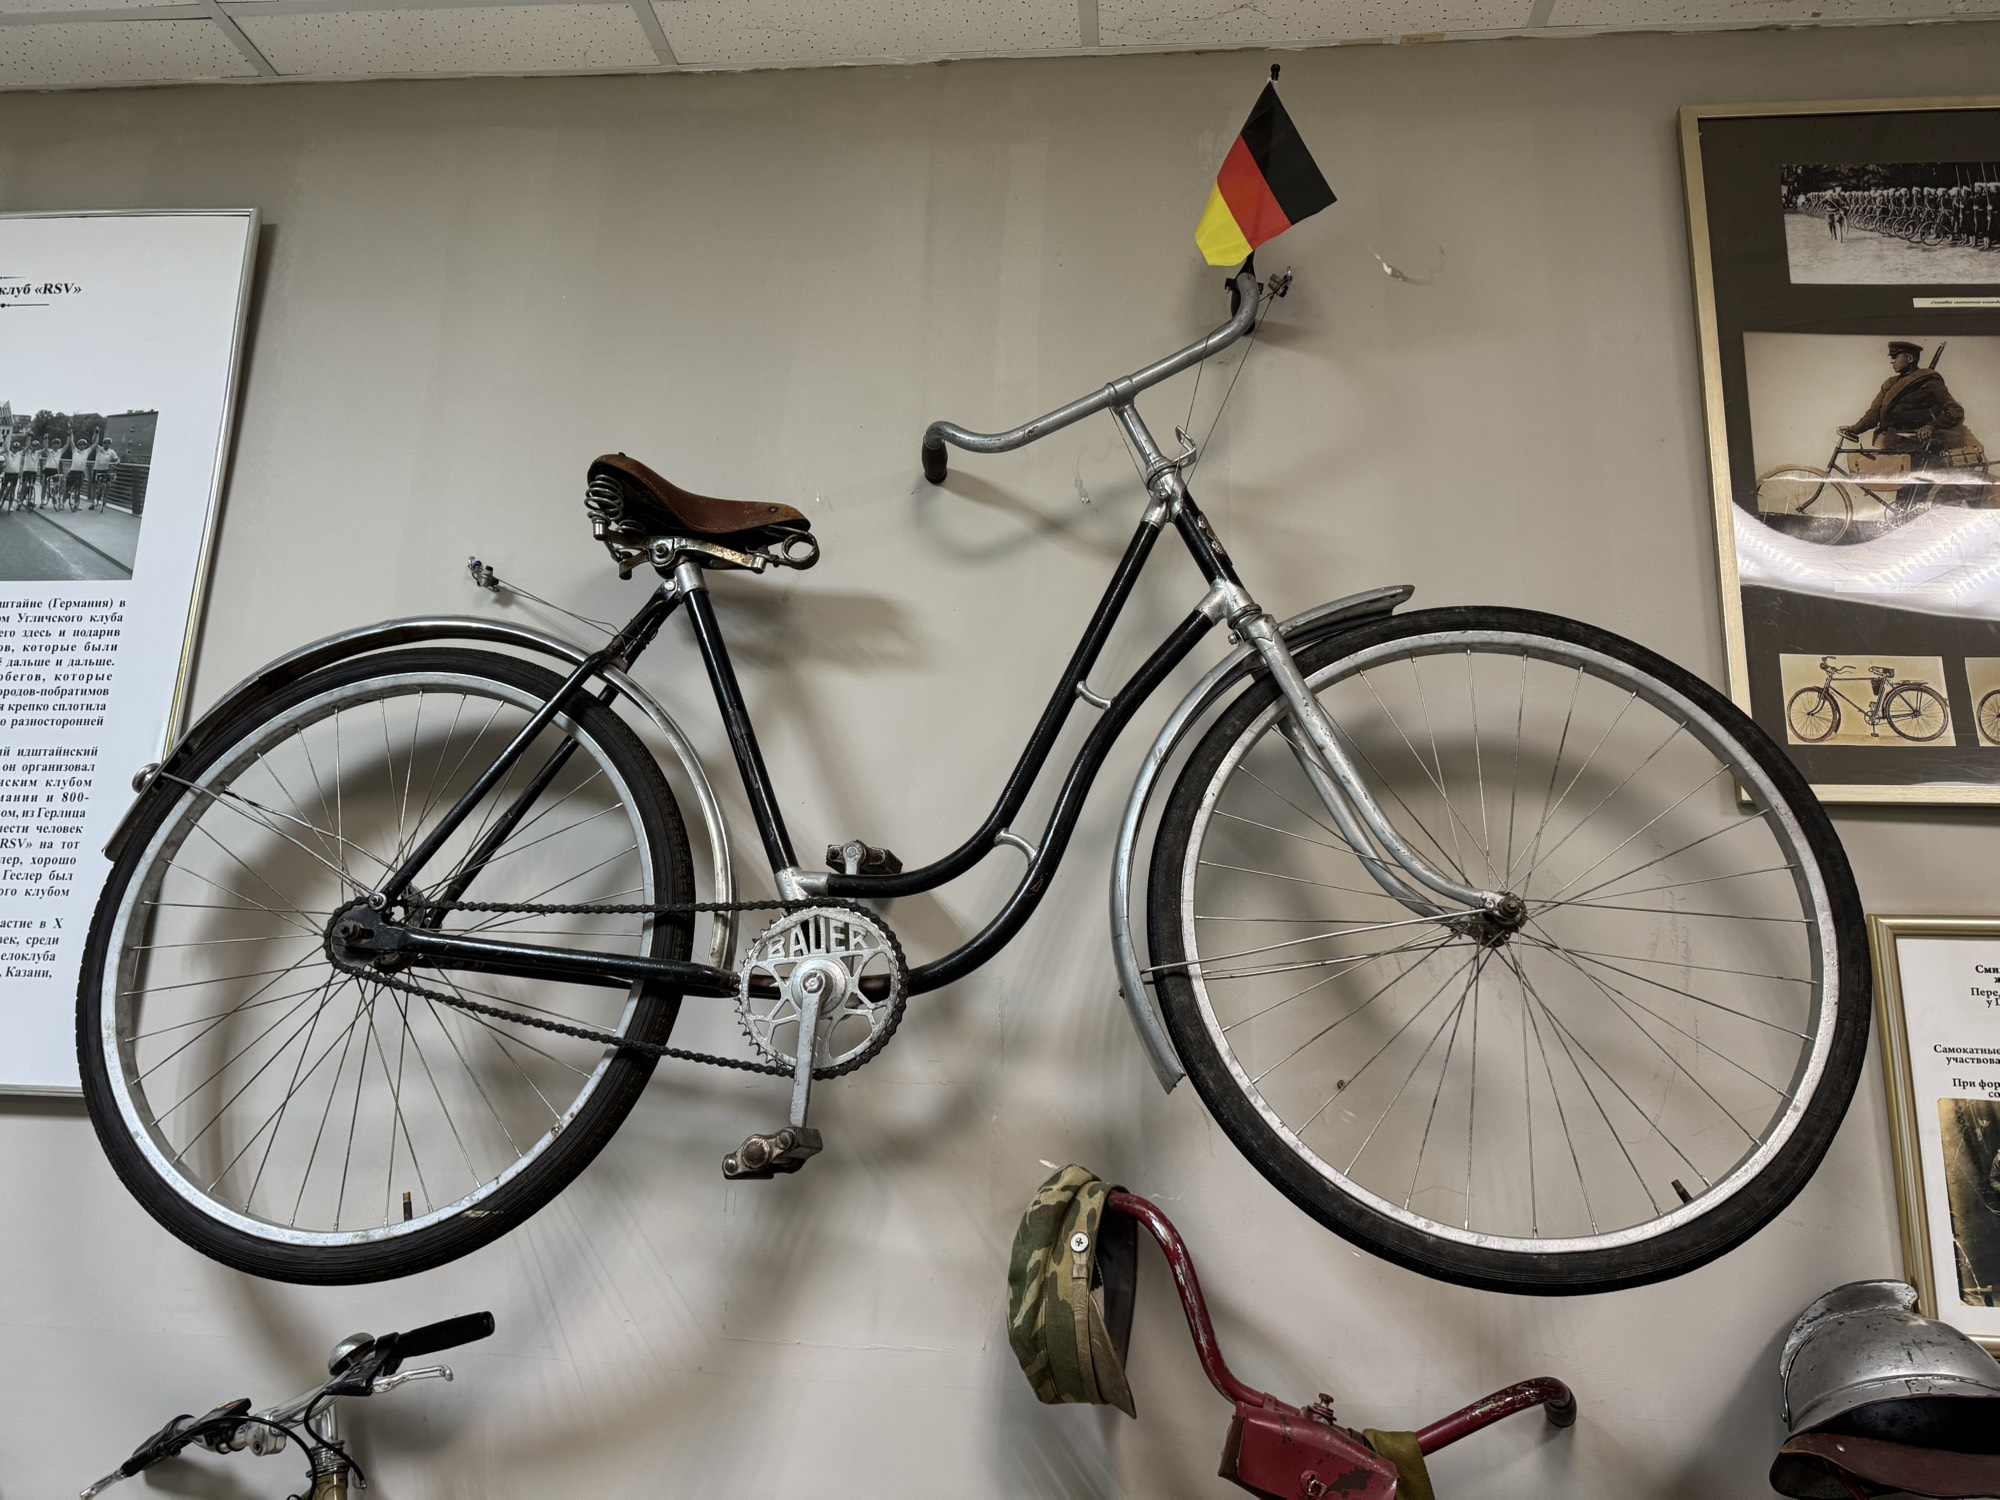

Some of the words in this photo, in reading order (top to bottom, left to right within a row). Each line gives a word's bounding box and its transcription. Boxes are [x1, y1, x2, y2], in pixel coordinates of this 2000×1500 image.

[0, 283, 31, 298] клуб
[34, 282, 82, 295] «RSV»
[0, 598, 43, 609] штайне
[48, 597, 114, 611] (Германия)
[119, 600, 126, 608] в
[0, 615, 10, 623] м
[17, 612, 83, 623] Угличского
[89, 612, 124, 625] клуба
[22, 629, 52, 638] здесь
[58, 629, 66, 637] и
[72, 628, 121, 640] подарив
[22, 643, 77, 655] которые
[84, 641, 118, 652] были
[5, 657, 51, 668] дальше
[55, 658, 63, 667] и
[67, 657, 115, 669] дальше.
[54, 672, 113, 683] которые
[8, 702, 49, 714] крепко
[52, 702, 107, 711] сплотила
[10, 715, 104, 729] разносторонней
[17, 746, 98, 758] идштайнский
[2, 763, 16, 772] он
[21, 763, 96, 775] организовал
[45, 776, 92, 790] клубом
[46, 794, 54, 803] и
[61, 790, 89, 803] 800-
[21, 809, 35, 818] из
[37, 806, 86, 821] Герлица
[36, 825, 84, 834] человек
[0, 837, 33, 850] RSV»
[39, 840, 54, 849] на
[60, 840, 80, 849] тот
[30, 855, 76, 867] хорошо
[2, 869, 43, 884] Геслер
[49, 869, 73, 881] был
[24, 885, 70, 899] клубом
[0, 919, 33, 929] астие
[39, 919, 46, 929] в
[26, 935, 59, 948] среди
[767, 916, 871, 960] BAUER
[0, 949, 56, 964] елоклуба
[5, 965, 52, 980] Казани,
[1970, 987, 2000, 999] Пере
[1986, 999, 1993, 1008] у
[1933, 1043, 2000, 1055] Самокатные
[1945, 1056, 2000, 1066] участвова
[1952, 1077, 1976, 1090] При
